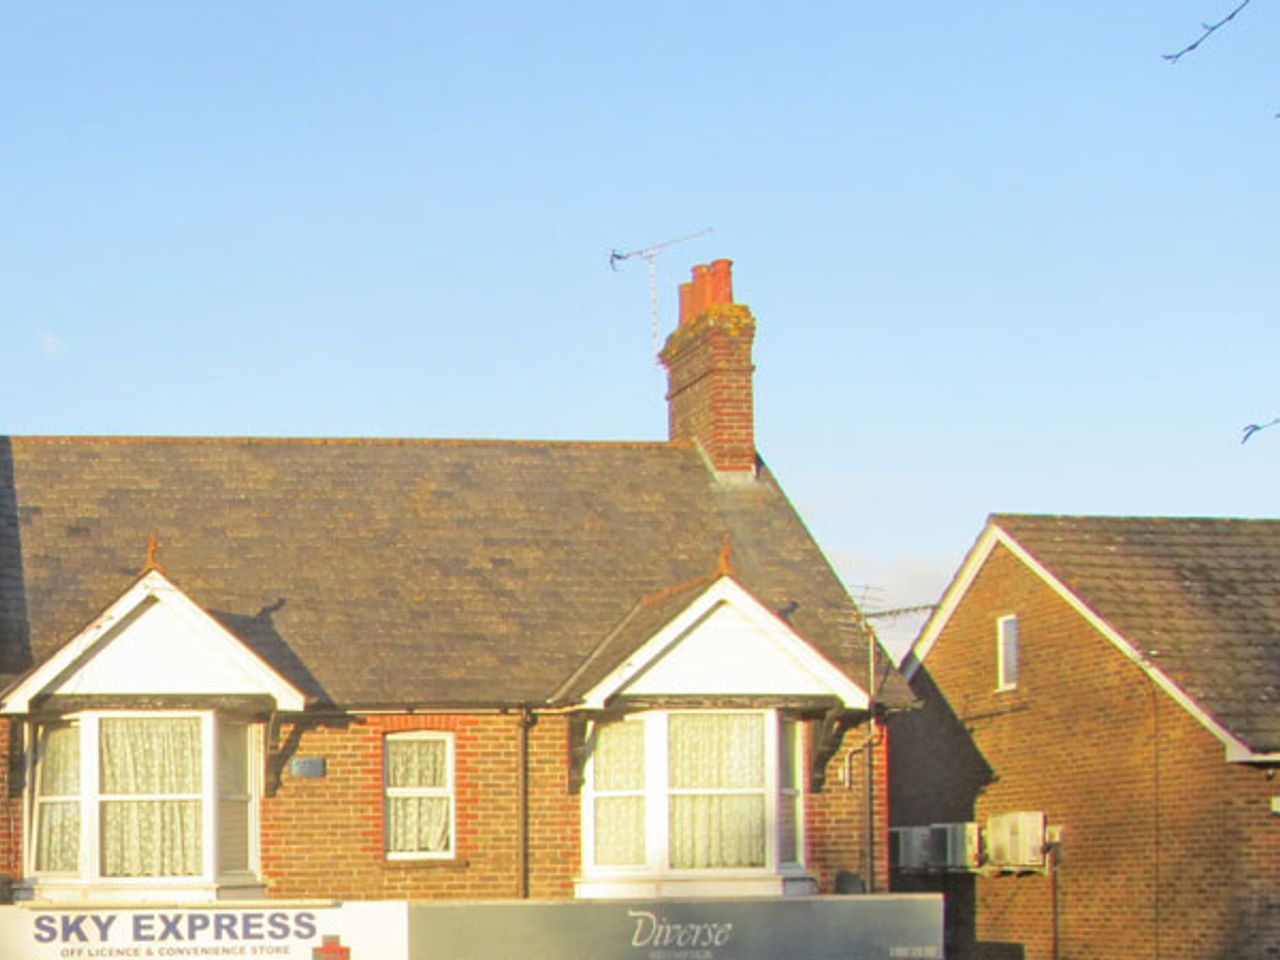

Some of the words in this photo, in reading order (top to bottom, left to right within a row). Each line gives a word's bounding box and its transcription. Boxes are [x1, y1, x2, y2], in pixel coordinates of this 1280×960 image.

[34, 913, 117, 943] SKY
[133, 911, 317, 940] EXPRESS
[628, 909, 733, 948] Diverse
[60, 948, 83, 957] OFF
[87, 947, 141, 957] LICENCE
[158, 946, 246, 956] CONVENIENCE
[251, 945, 290, 955] STORE
